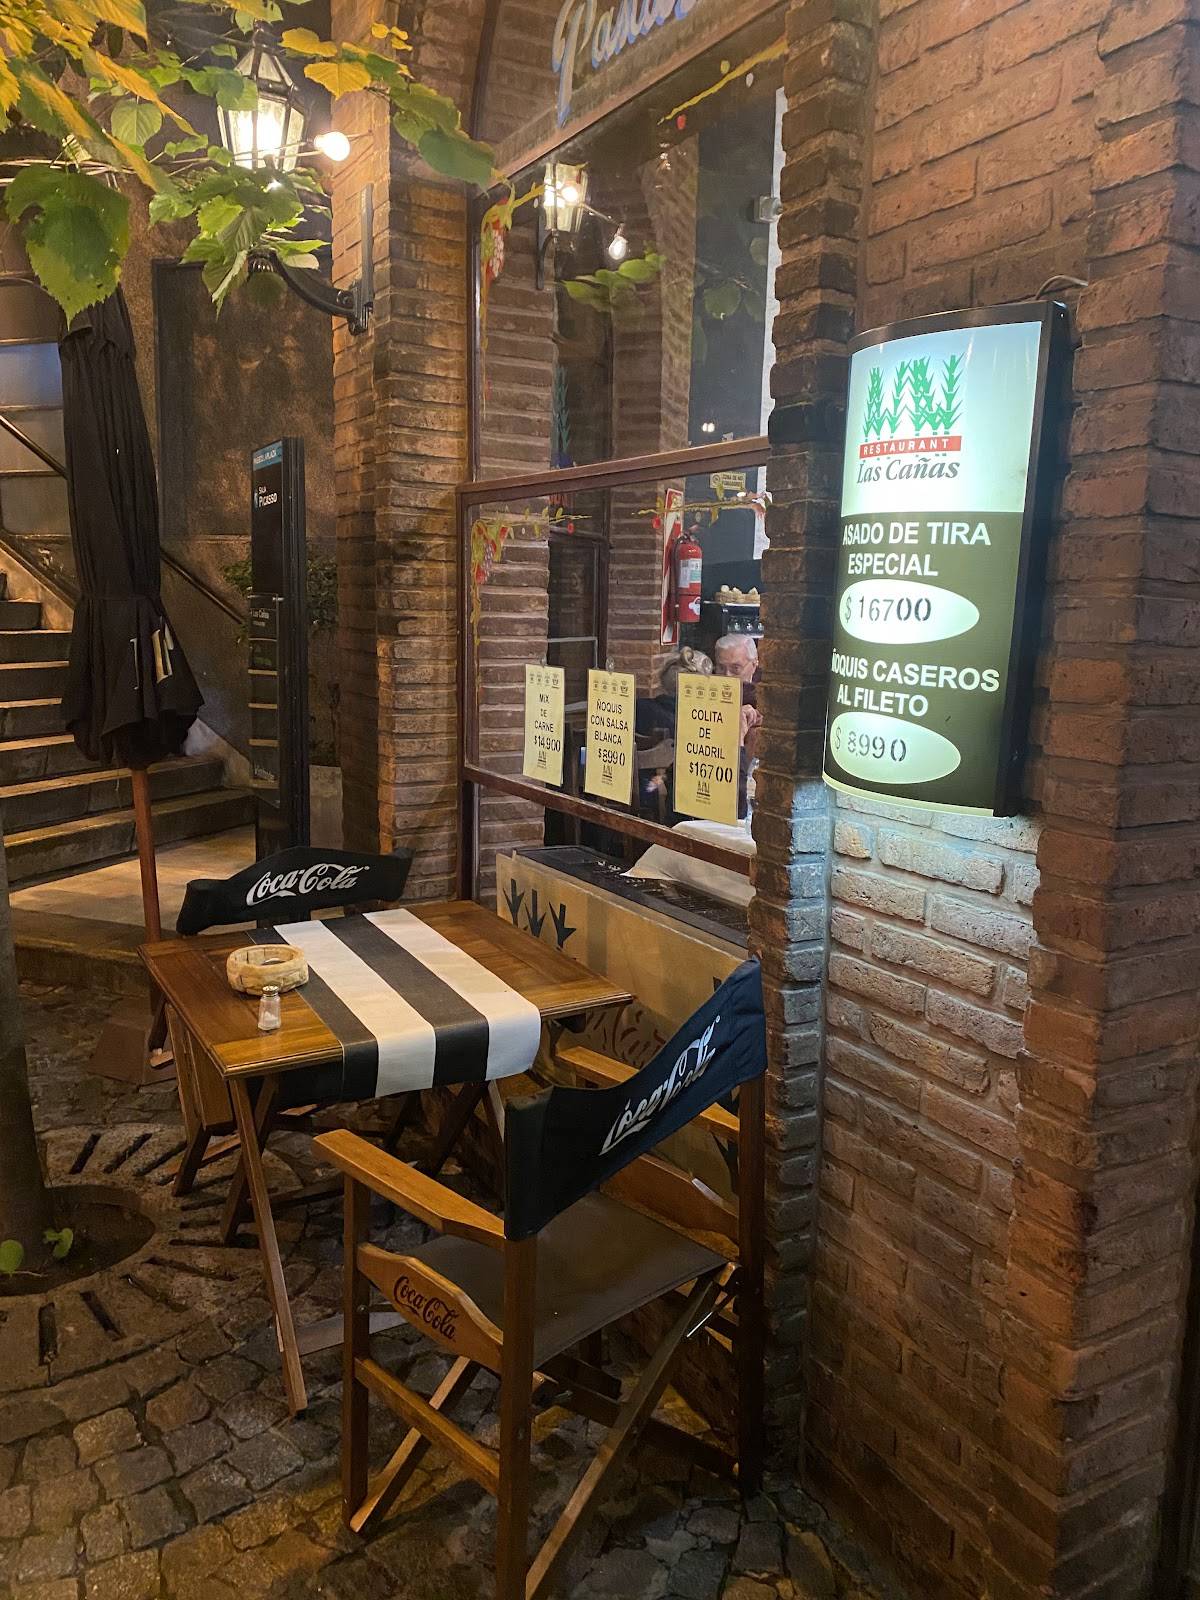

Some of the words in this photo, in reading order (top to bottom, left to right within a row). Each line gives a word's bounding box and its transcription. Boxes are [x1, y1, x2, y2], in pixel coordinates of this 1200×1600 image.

[863, 438, 949, 455] RESTAURANT
[857, 461, 882, 484] Las
[886, 457, 960, 481] Cañas
[842, 522, 884, 546] ASADO
[889, 522, 919, 544] DE
[926, 522, 991, 546] TIRA
[848, 553, 939, 577] ESPECIAL
[872, 659, 1000, 692] CASEROS
[596, 698, 623, 715] ÑOQUIS
[836, 684, 851, 707] AL
[853, 686, 929, 717] FILETO
[590, 714, 605, 727] CON
[606, 717, 629, 732] SALSA
[691, 708, 724, 724] COLITA
[534, 719, 554, 733] CARNE
[698, 727, 711, 739] DE
[594, 730, 623, 746] BLANCA
[686, 742, 726, 760] CUADRIL
[246, 863, 370, 906] Coca-Cola
[393, 1275, 459, 1340] Coca-Cola
